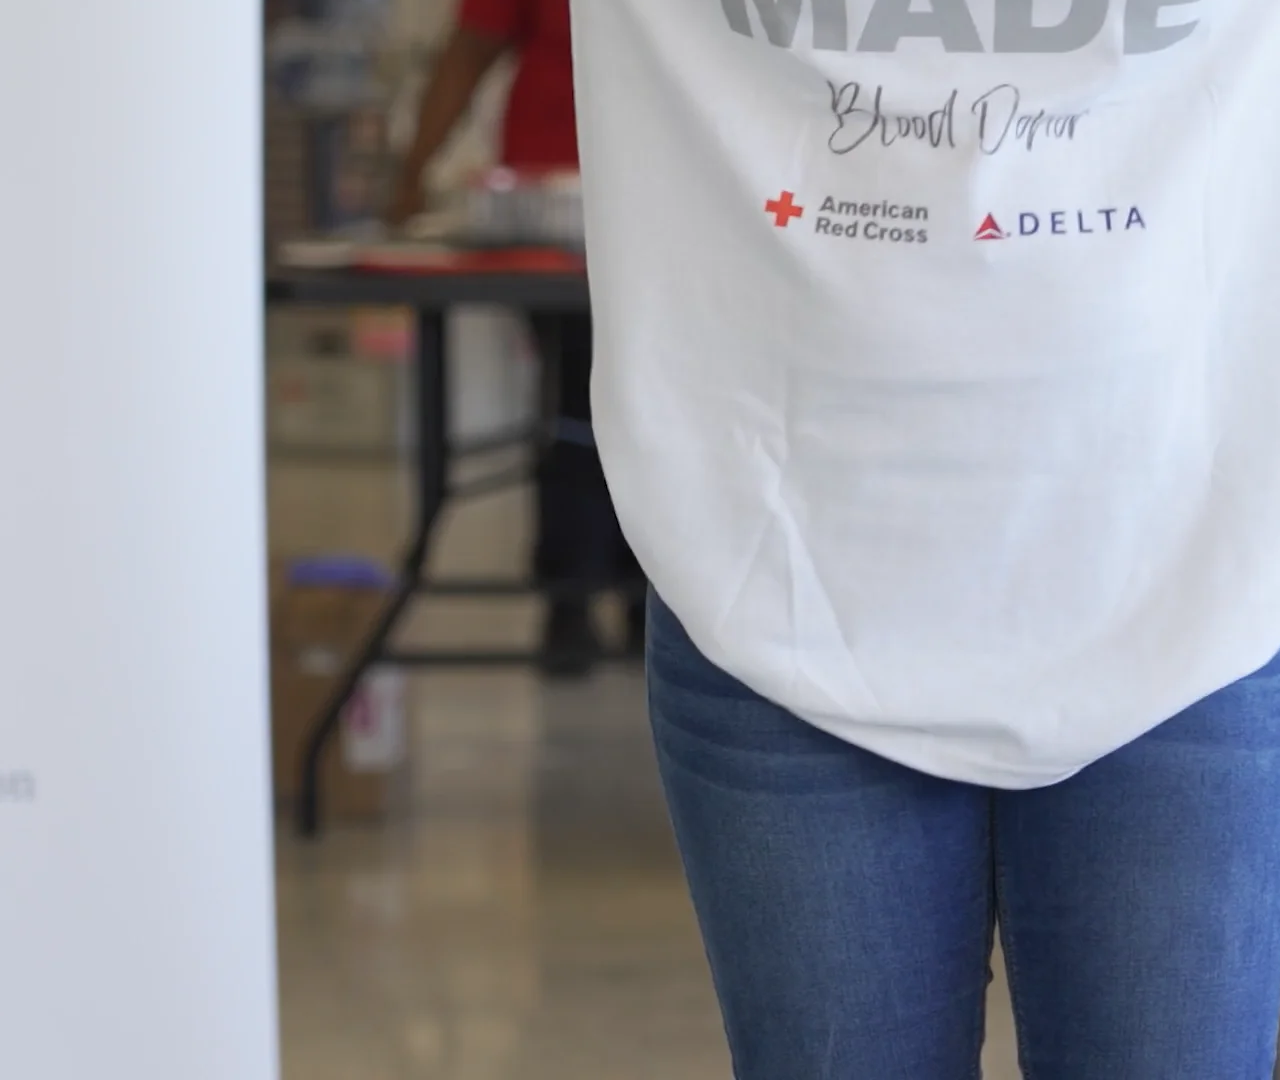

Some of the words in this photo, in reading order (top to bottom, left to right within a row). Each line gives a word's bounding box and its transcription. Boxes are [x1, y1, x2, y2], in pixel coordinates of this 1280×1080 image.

[826, 80, 957, 156] Blood
[818, 195, 929, 222] American
[1019, 207, 1146, 237] DELTA
[815, 216, 859, 240] Red
[863, 220, 928, 244] Cross
